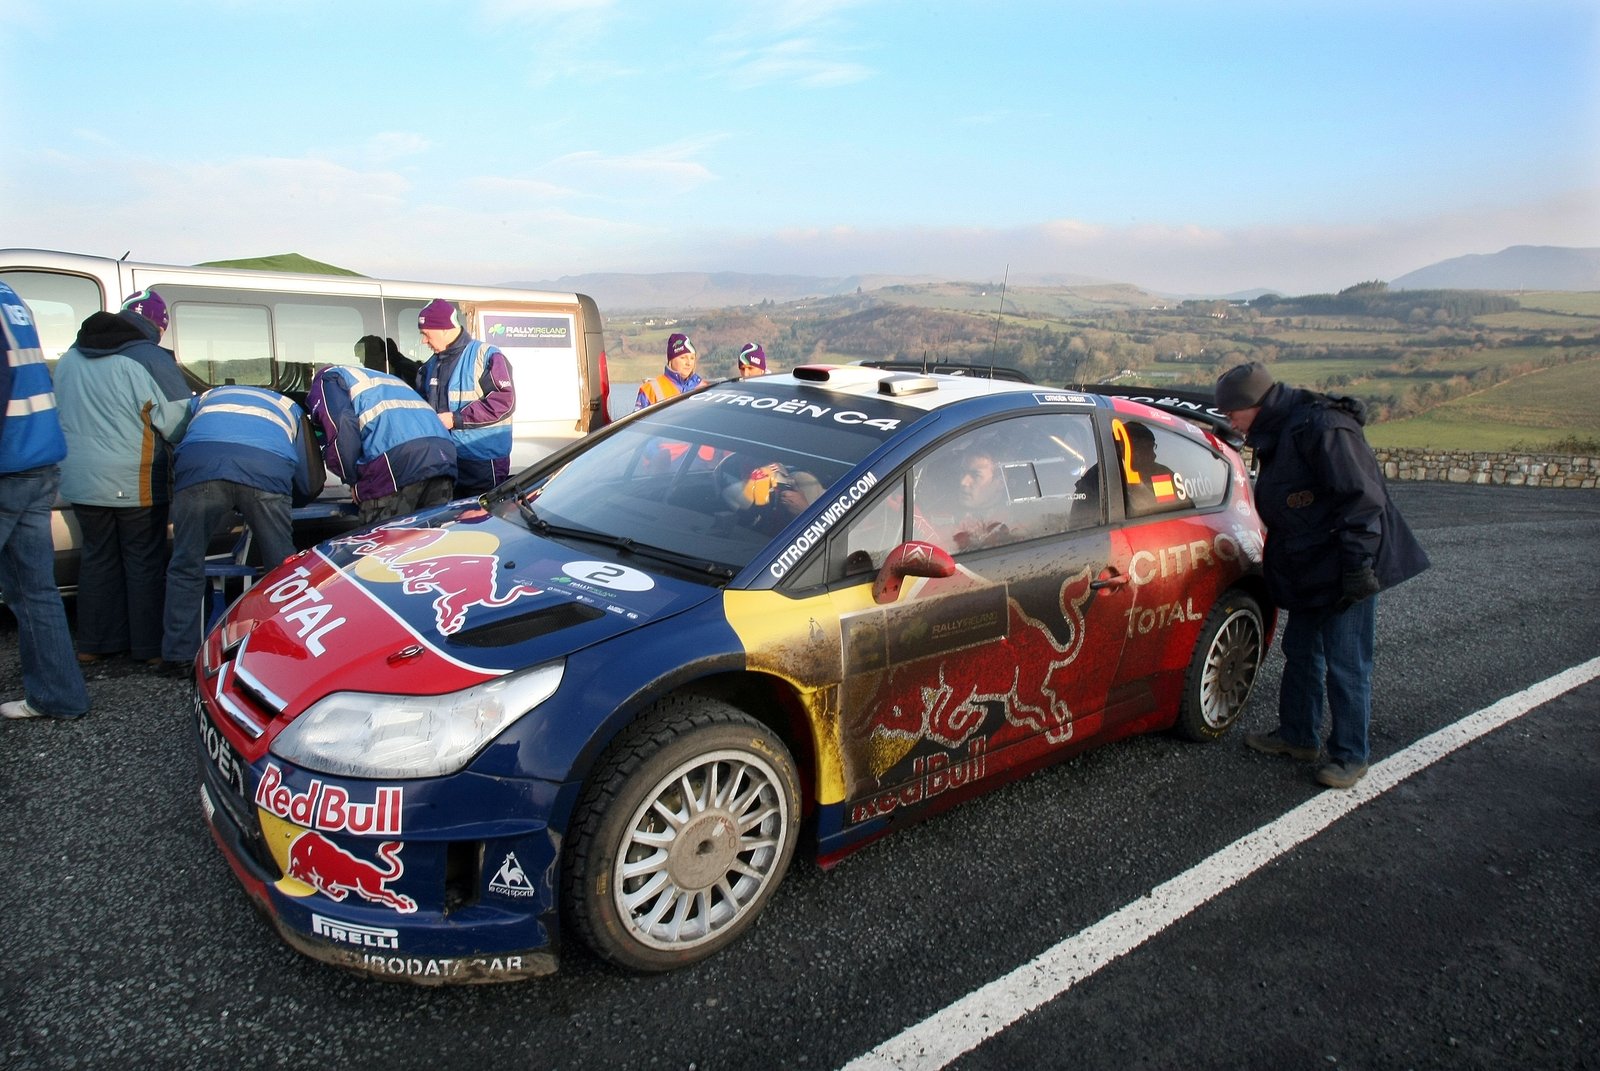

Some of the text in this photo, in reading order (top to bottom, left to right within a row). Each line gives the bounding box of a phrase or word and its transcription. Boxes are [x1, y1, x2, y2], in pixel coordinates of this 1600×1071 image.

[689, 392, 901, 432] CITROËN C4
[1112, 418, 1141, 484] 2
[1173, 472, 1213, 500] Sordo
[770, 471, 878, 578] CITROEN-WRC.COM
[585, 565, 625, 584] 2
[263, 566, 346, 658] TOTAL
[1124, 598, 1203, 639] TOTAL
[926, 735, 986, 799] Bull
[255, 762, 322, 829] Red
[315, 784, 403, 836] Bull
[312, 913, 399, 949] PIRELLI
